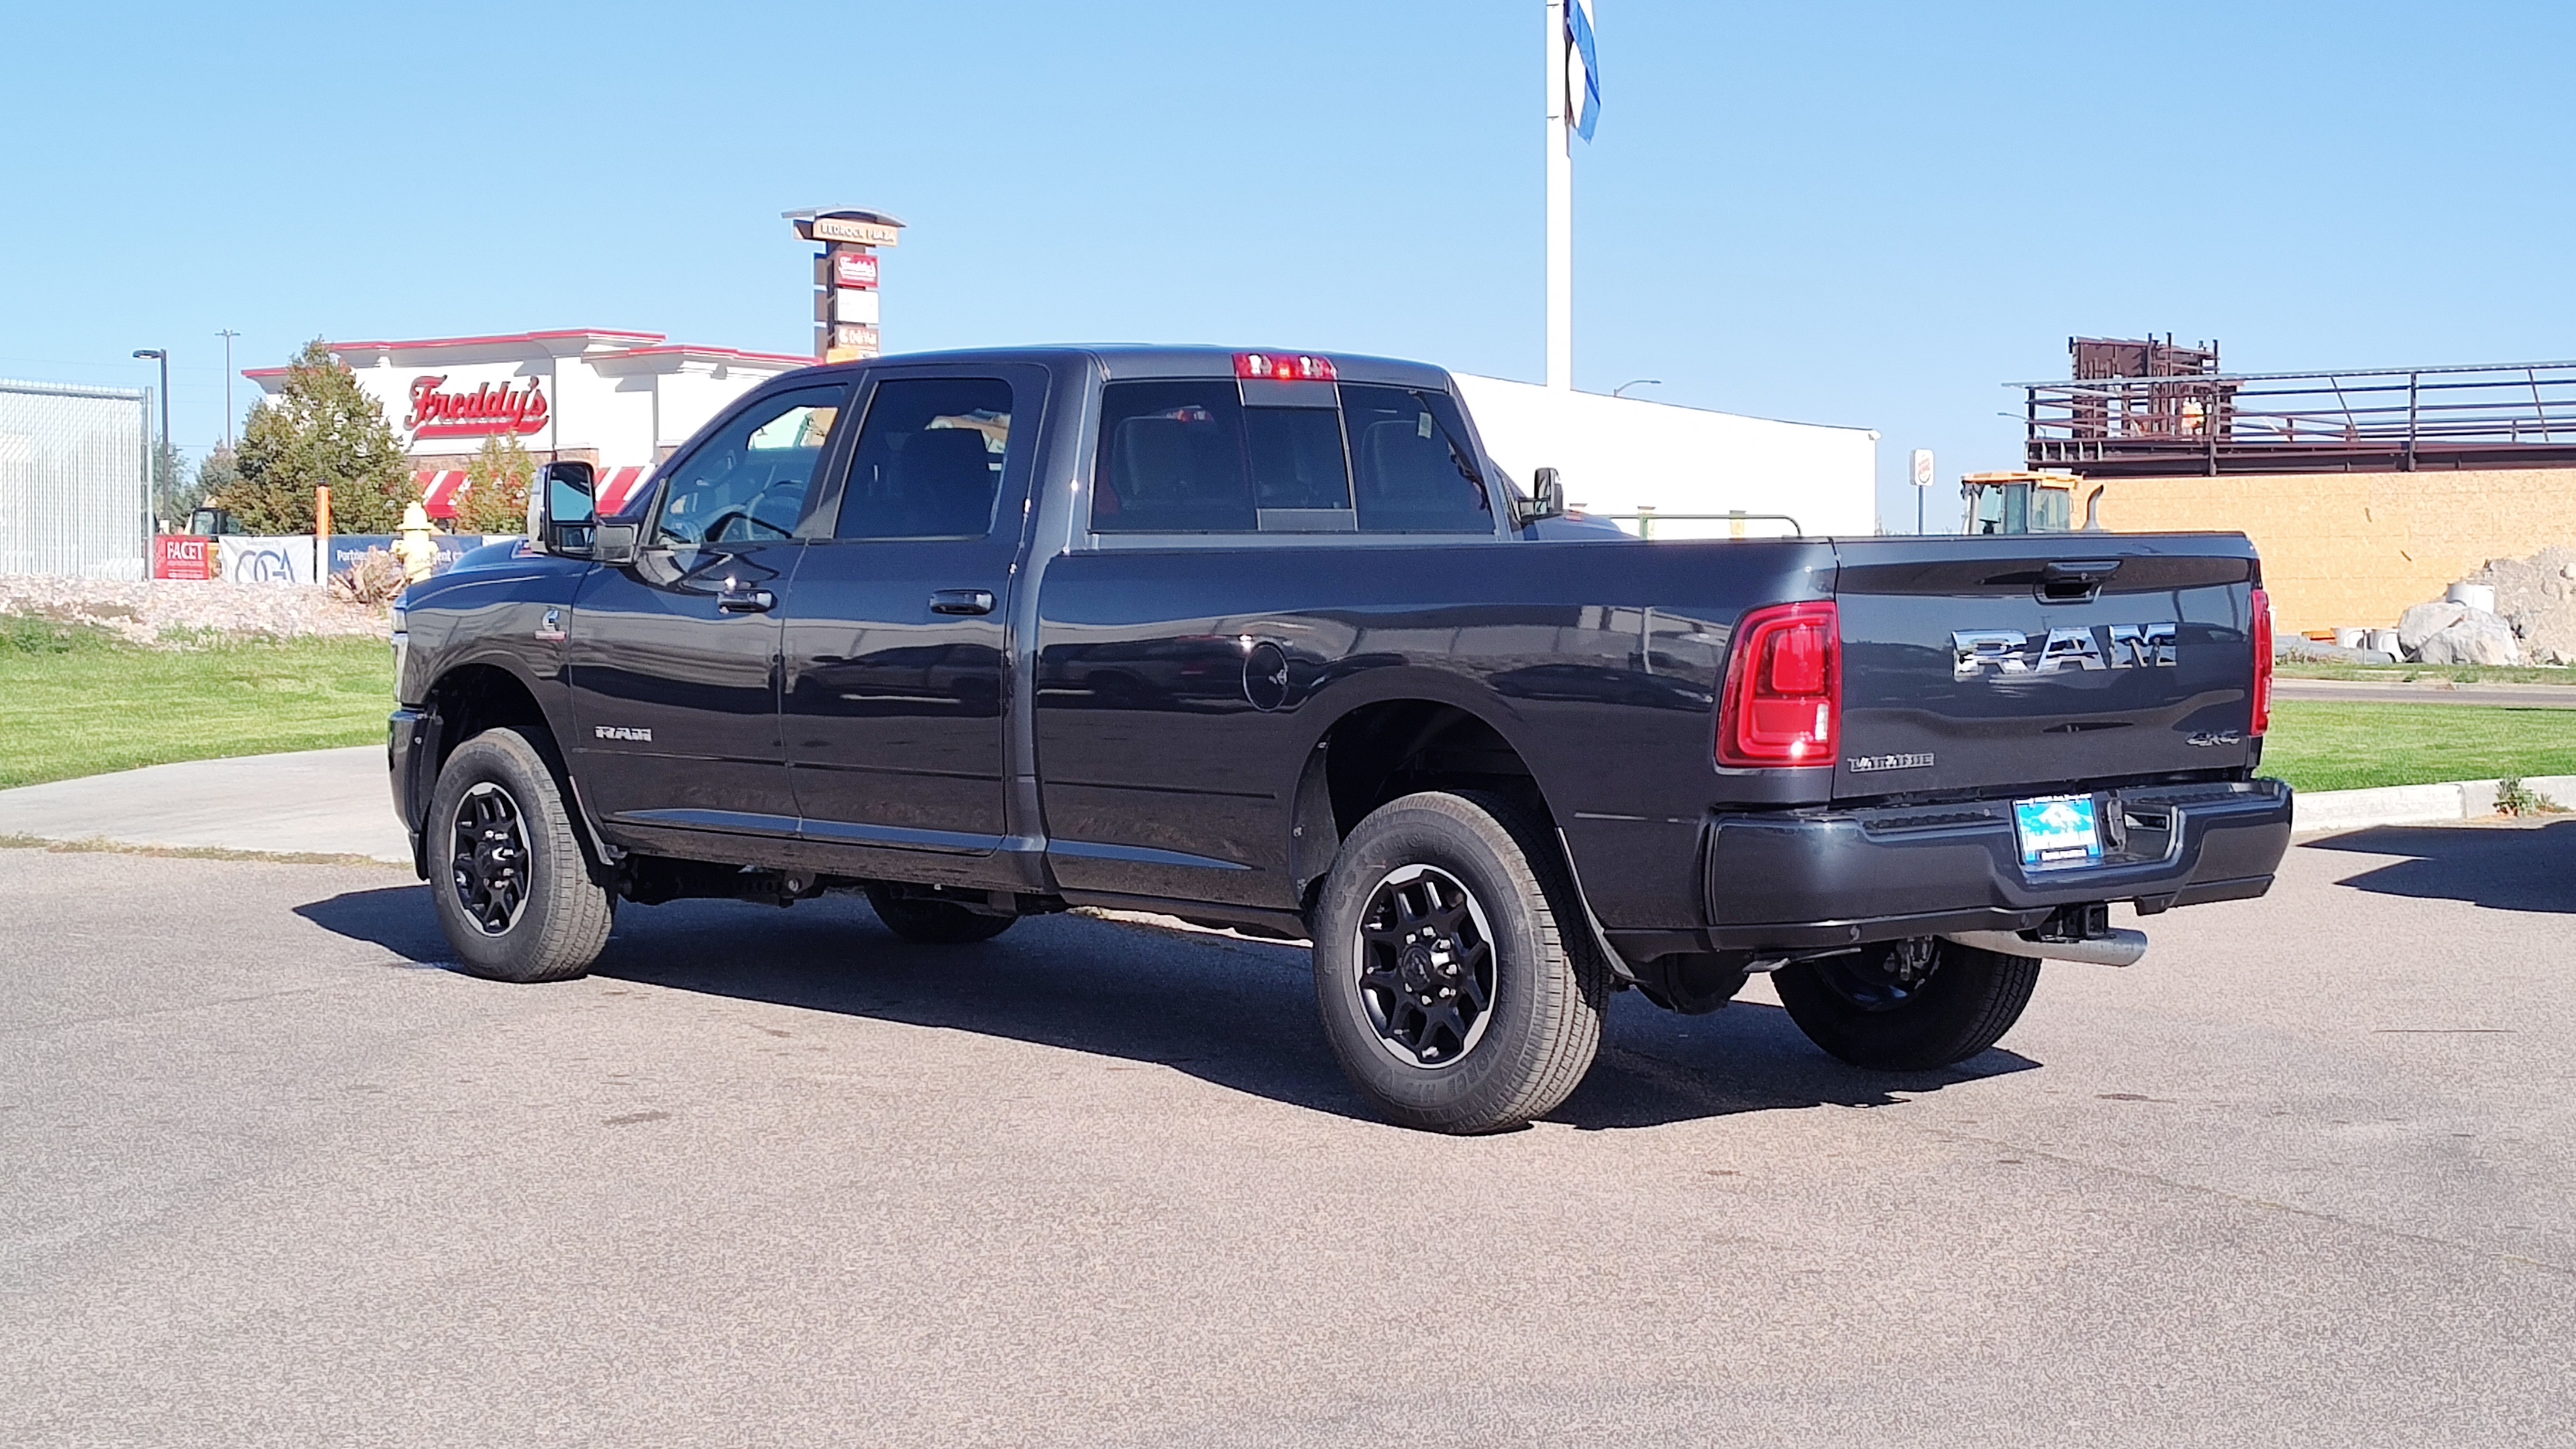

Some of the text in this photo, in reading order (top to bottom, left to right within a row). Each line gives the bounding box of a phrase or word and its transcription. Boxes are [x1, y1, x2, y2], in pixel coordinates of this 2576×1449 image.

[866, 228, 894, 242] PLAZA
[403, 375, 548, 431] Freddy's
[167, 541, 204, 560] FACET
[1951, 623, 2177, 681] RAM
[594, 726, 652, 741] RAM
[1847, 753, 1935, 772] LARAMIE
